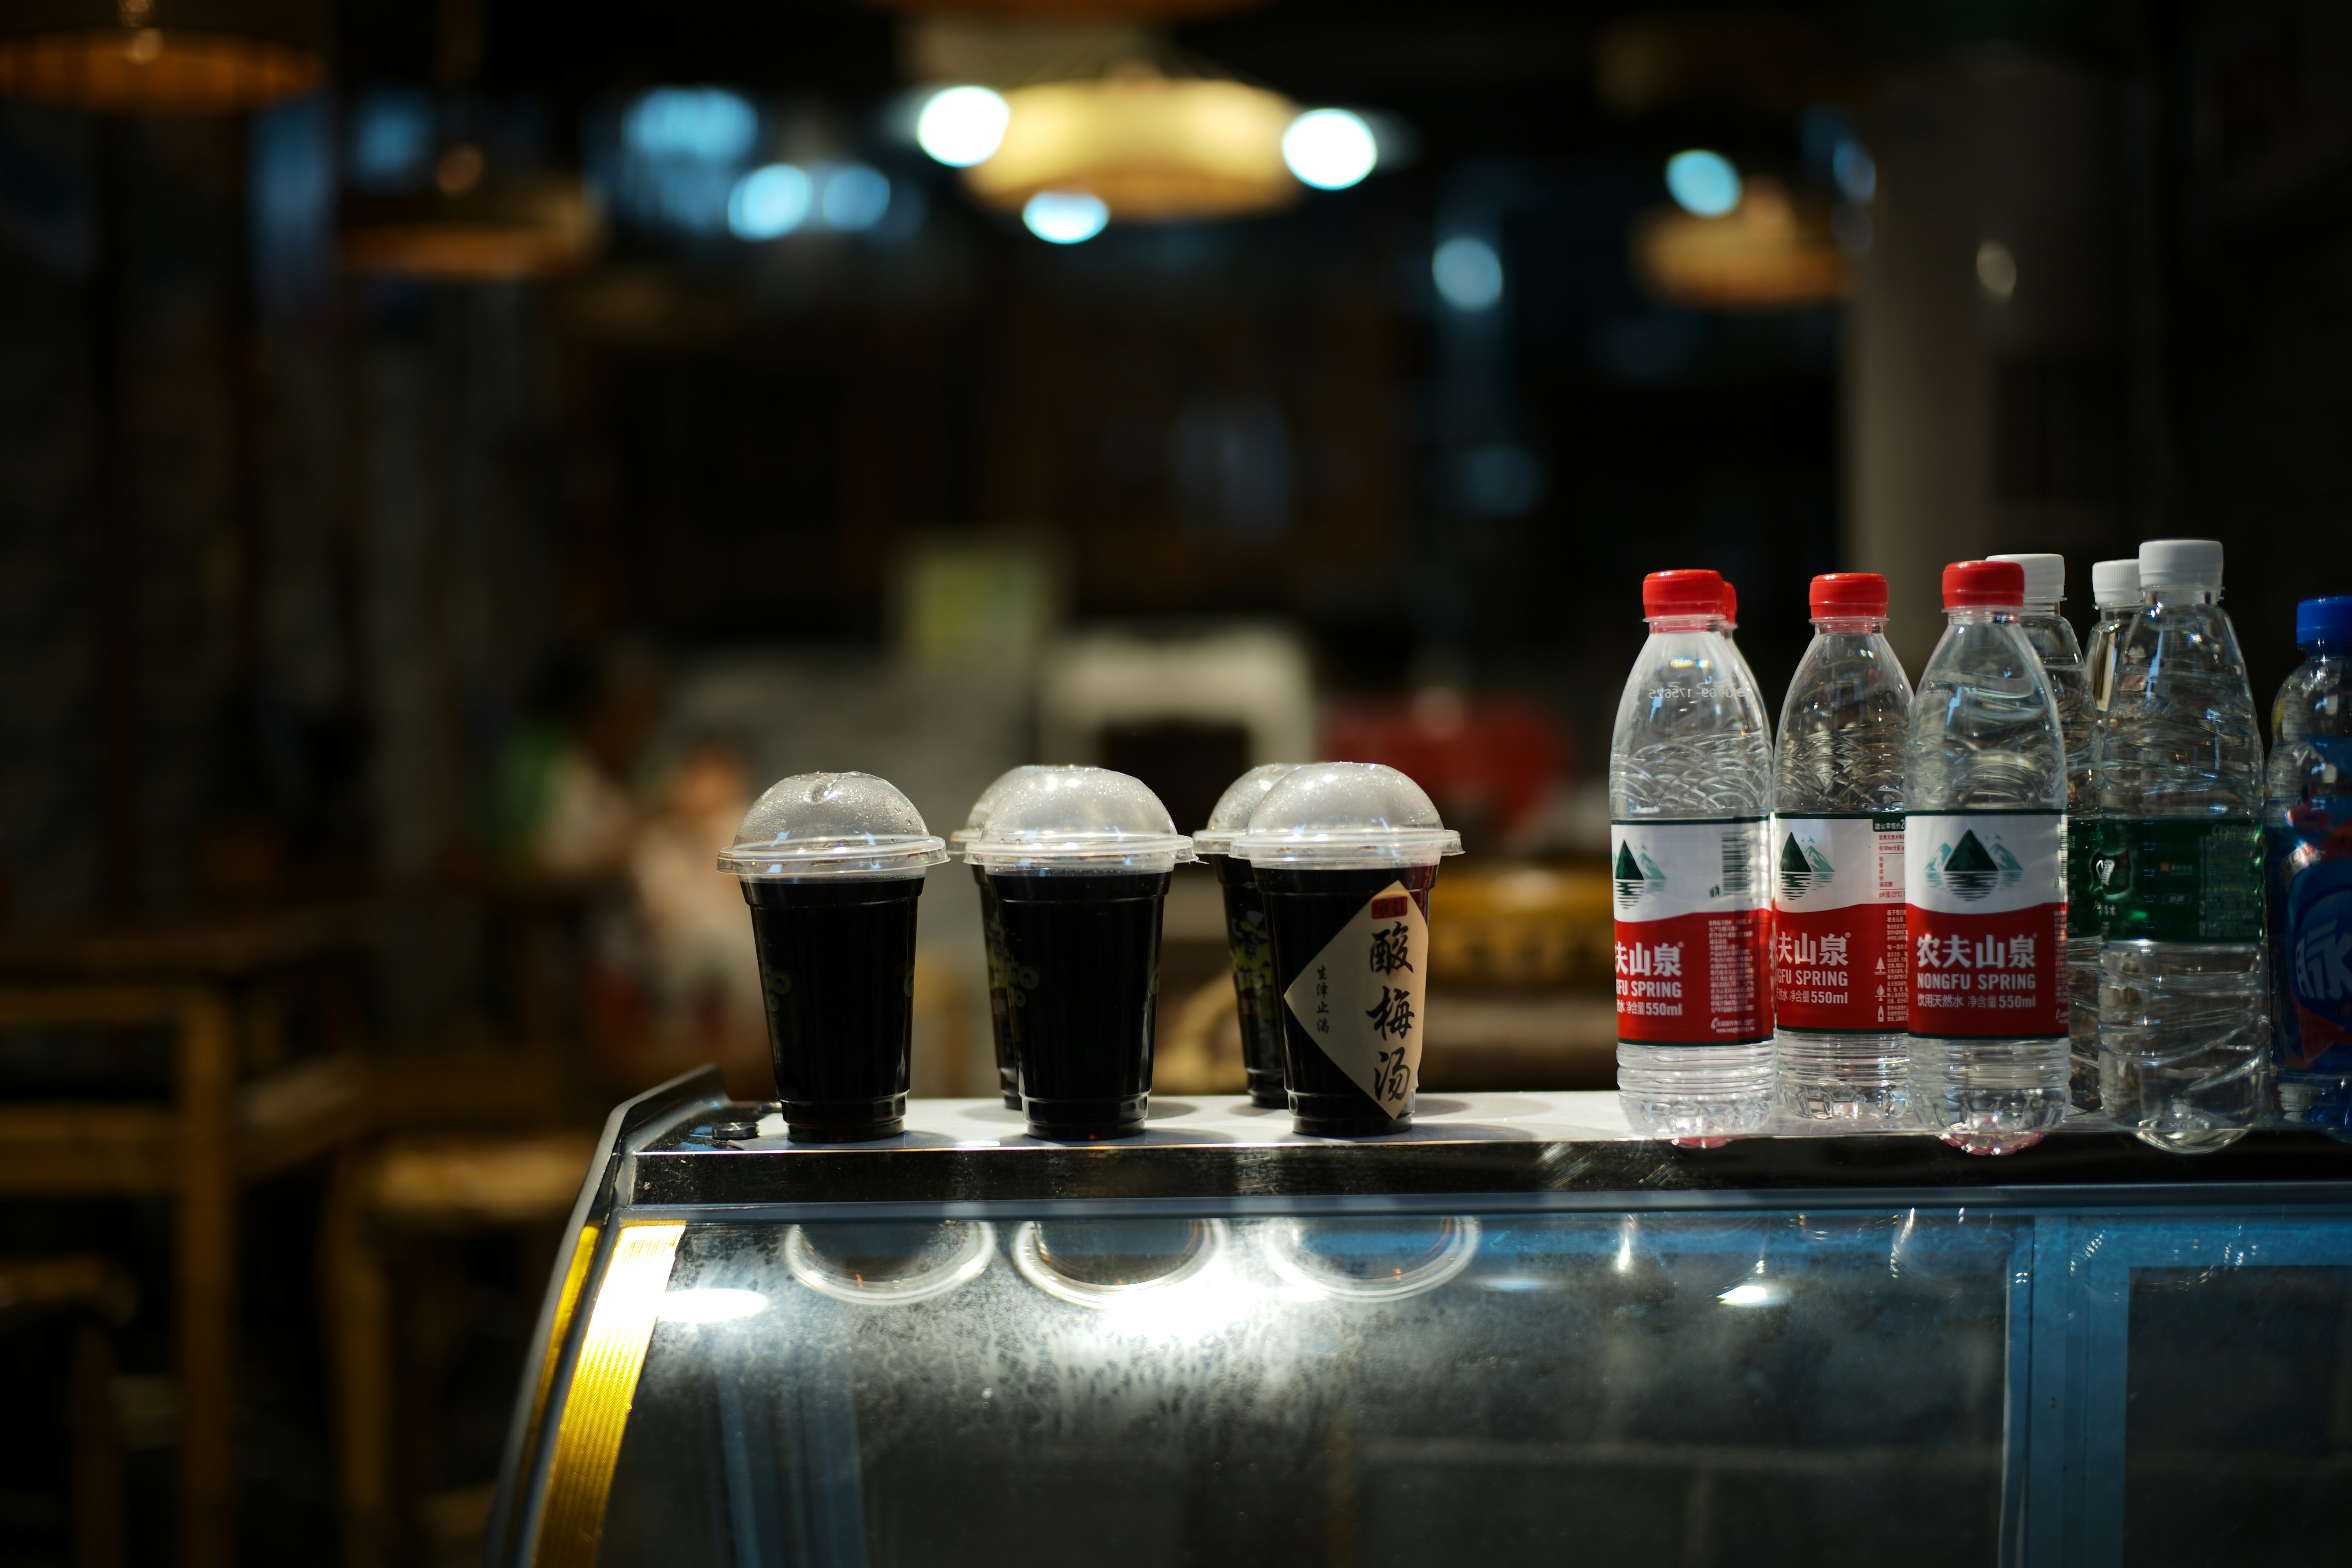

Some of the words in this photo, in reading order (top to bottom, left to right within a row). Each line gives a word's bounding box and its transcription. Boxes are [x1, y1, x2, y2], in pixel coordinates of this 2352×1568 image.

[1615, 940, 1682, 977] 夫山泉
[1917, 933, 2036, 969] 农夫山泉
[1795, 970, 1849, 986] SPRING
[1917, 972, 1971, 990] NONGFU
[1977, 973, 2036, 990] SPRING
[1631, 980, 1683, 998] SPRING
[1917, 993, 1964, 1008] 饮用天然水
[1365, 921, 1414, 1102] 酸梅汤
